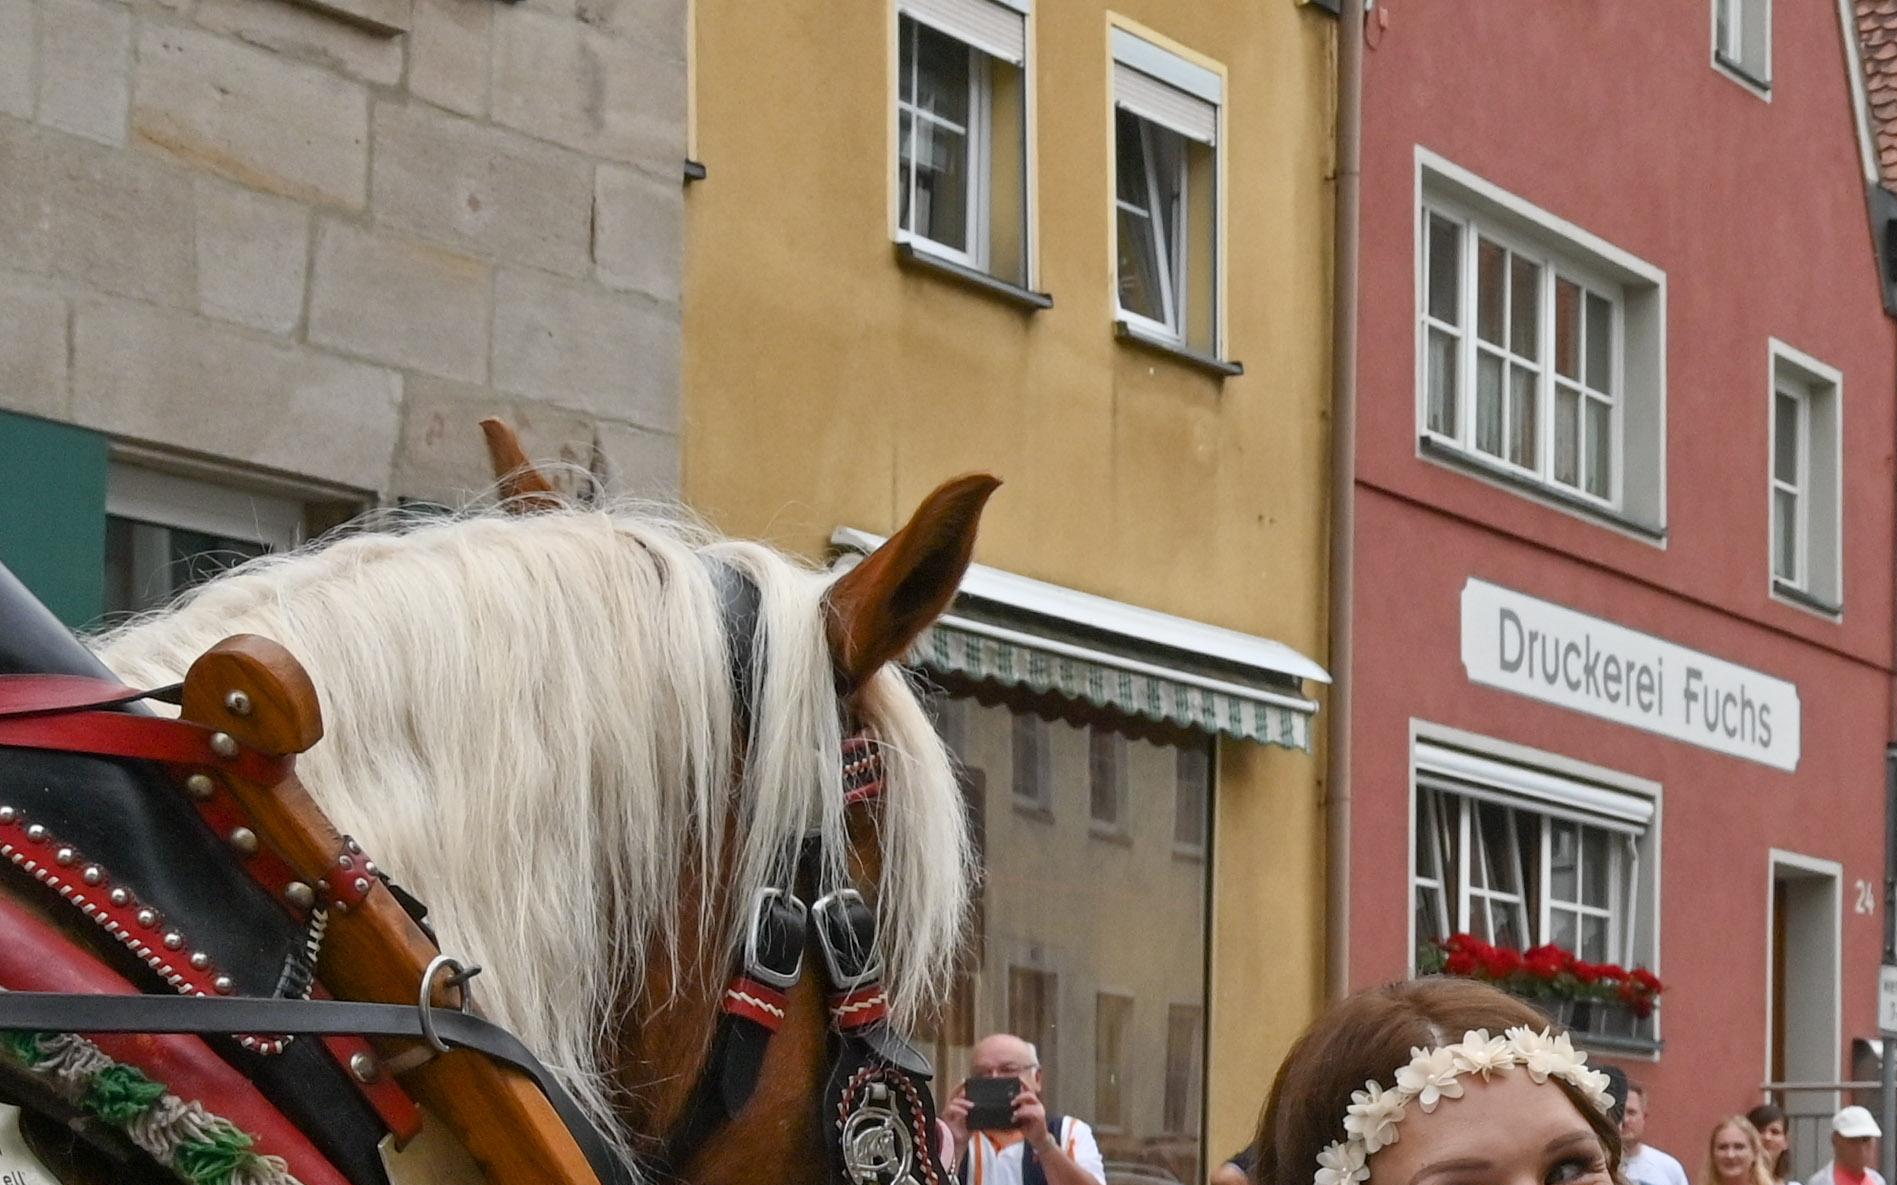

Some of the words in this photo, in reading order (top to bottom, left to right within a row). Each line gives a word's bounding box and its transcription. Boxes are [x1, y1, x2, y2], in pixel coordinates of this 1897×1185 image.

[1498, 606, 1664, 717] Druckerei
[1683, 666, 1772, 749] Fuchs
[1855, 879, 1876, 916] 24
